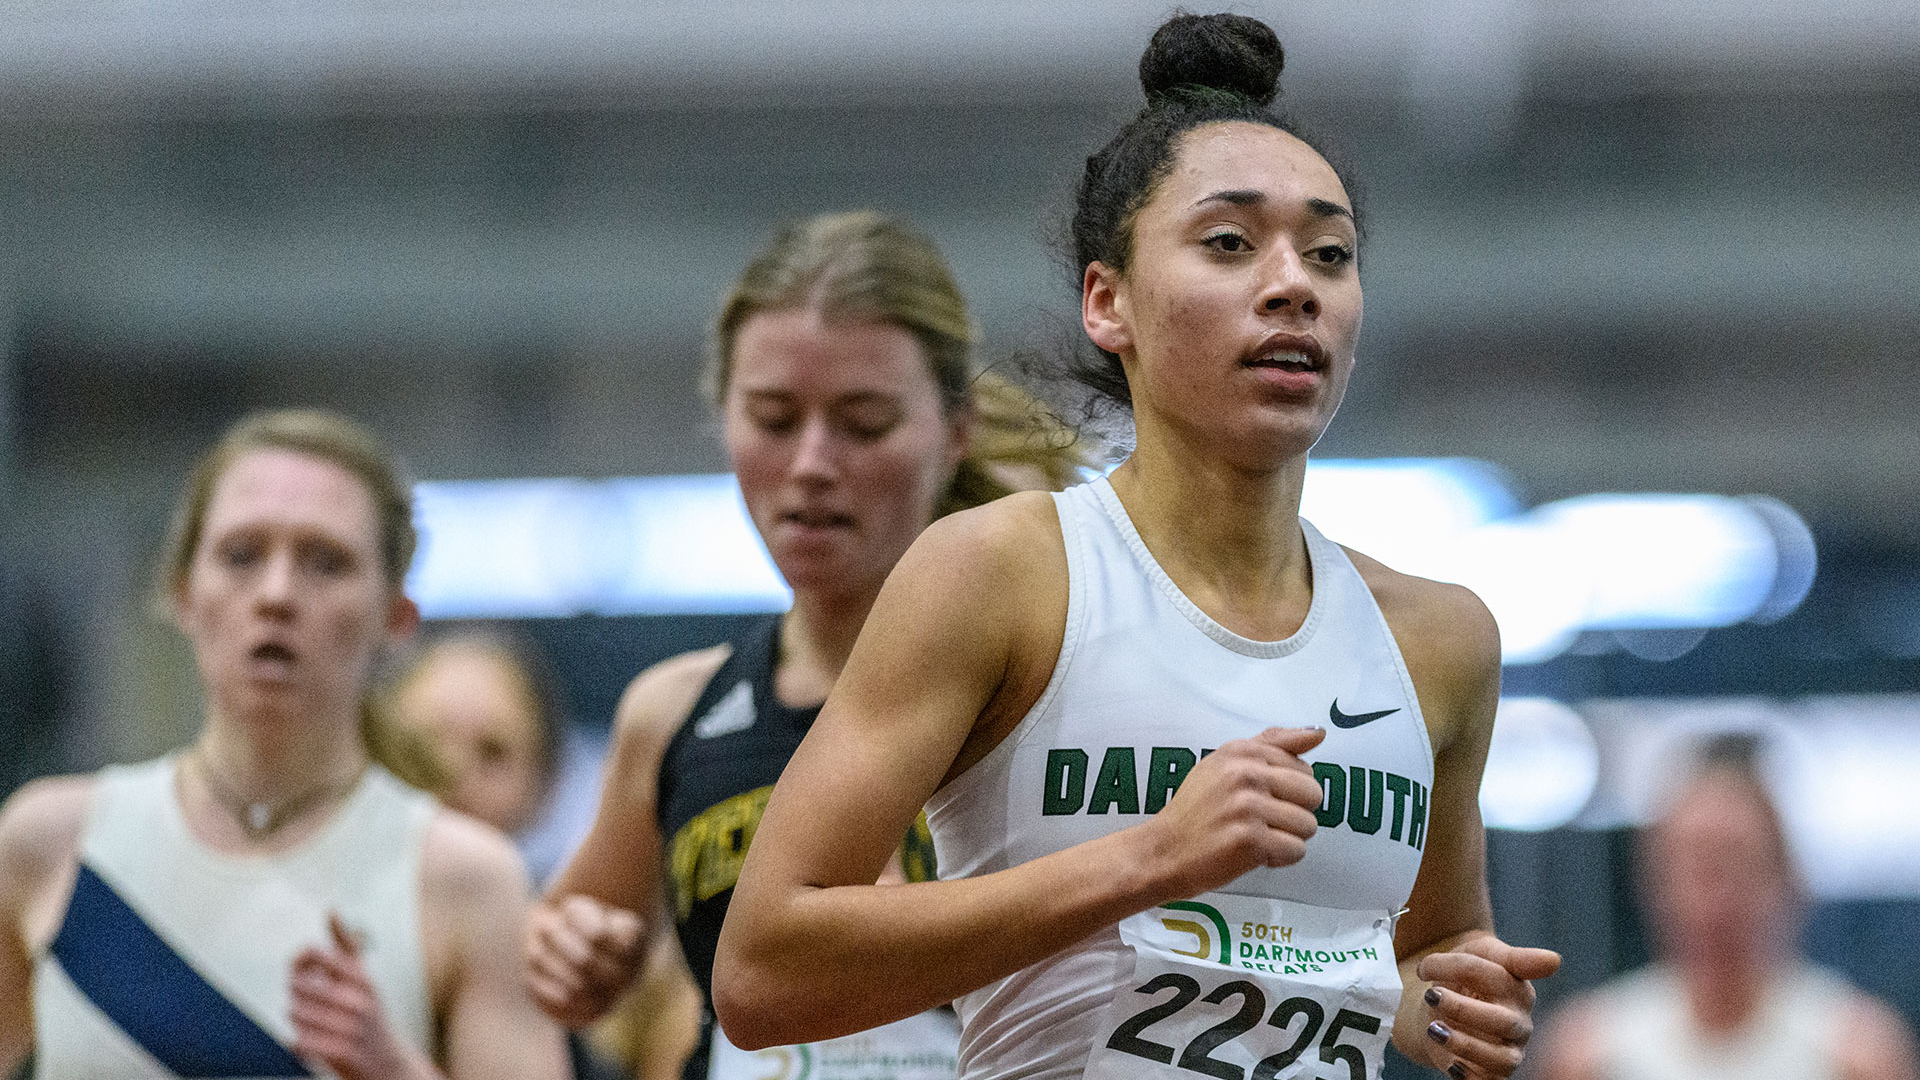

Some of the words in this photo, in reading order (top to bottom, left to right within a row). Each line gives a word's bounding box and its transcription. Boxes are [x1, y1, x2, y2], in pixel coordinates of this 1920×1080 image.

[1042, 747, 1428, 851] DAROUTH
[1239, 942, 1379, 964] DARTMOUTH
[1241, 922, 1293, 943] 50TH
[1105, 973, 1382, 1080] 2225
